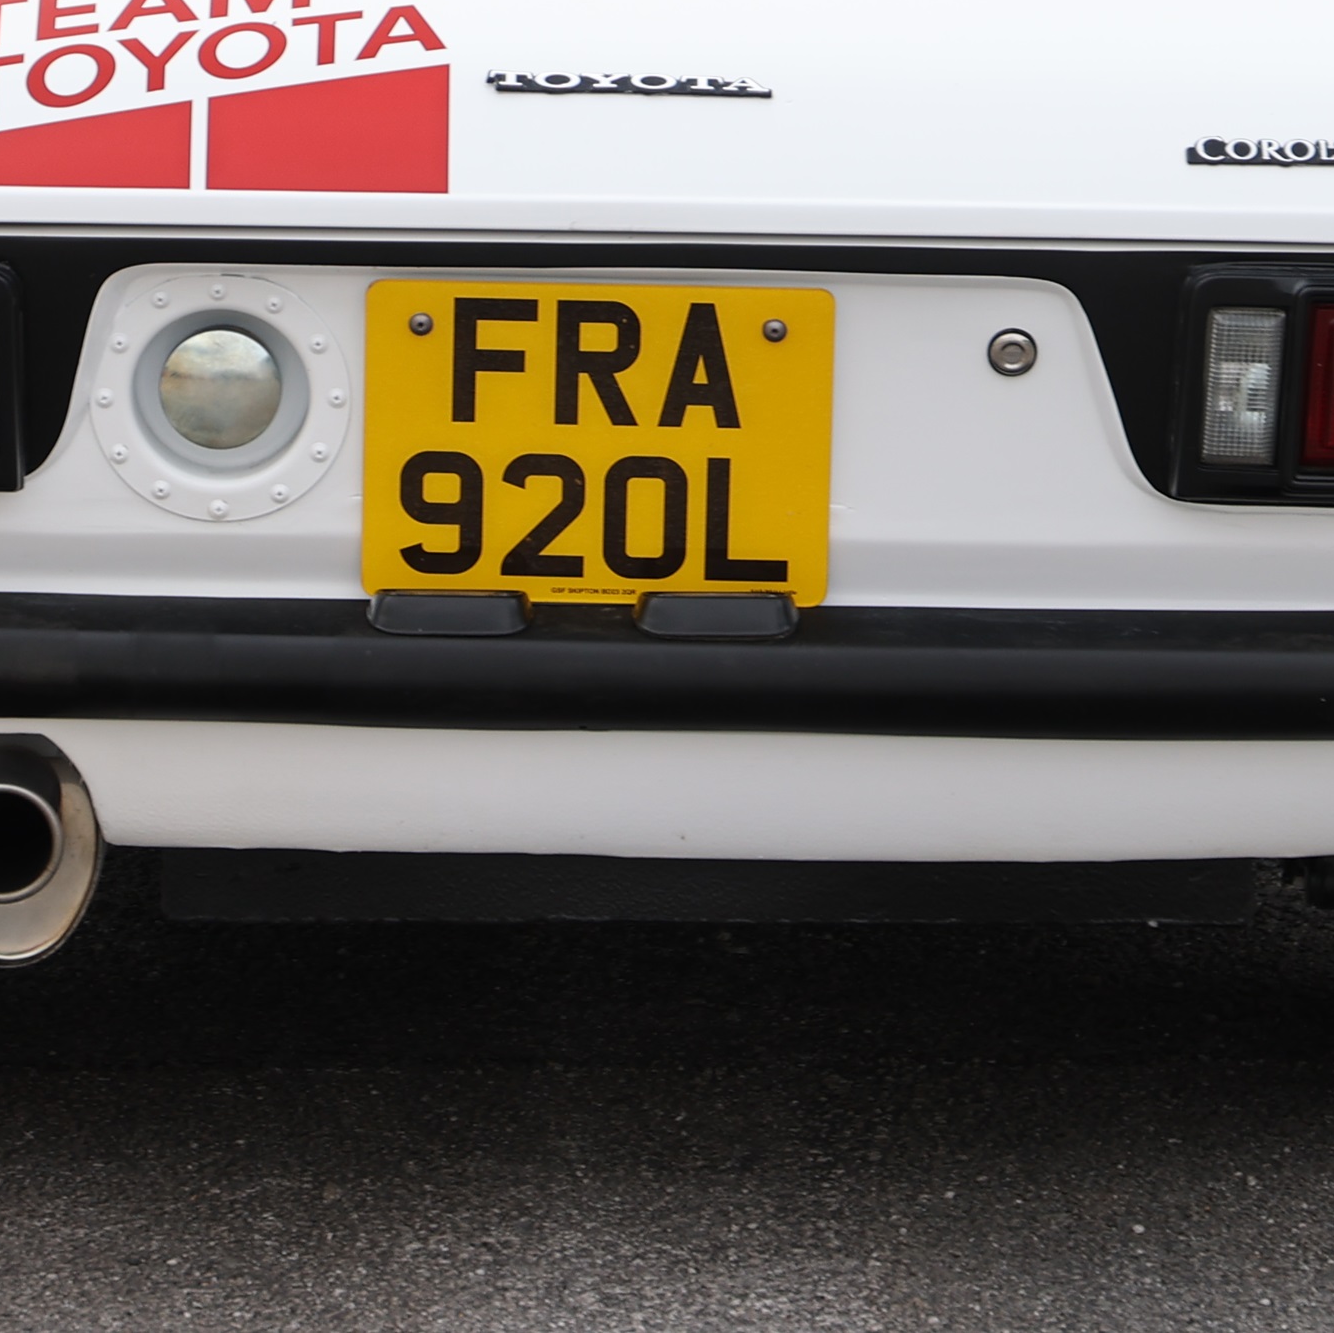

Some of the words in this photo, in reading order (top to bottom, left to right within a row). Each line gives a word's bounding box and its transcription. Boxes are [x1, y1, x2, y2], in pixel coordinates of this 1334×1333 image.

[486, 69, 771, 95] TOYOTA
[452, 297, 742, 429] FRA
[399, 450, 789, 583] 920L
